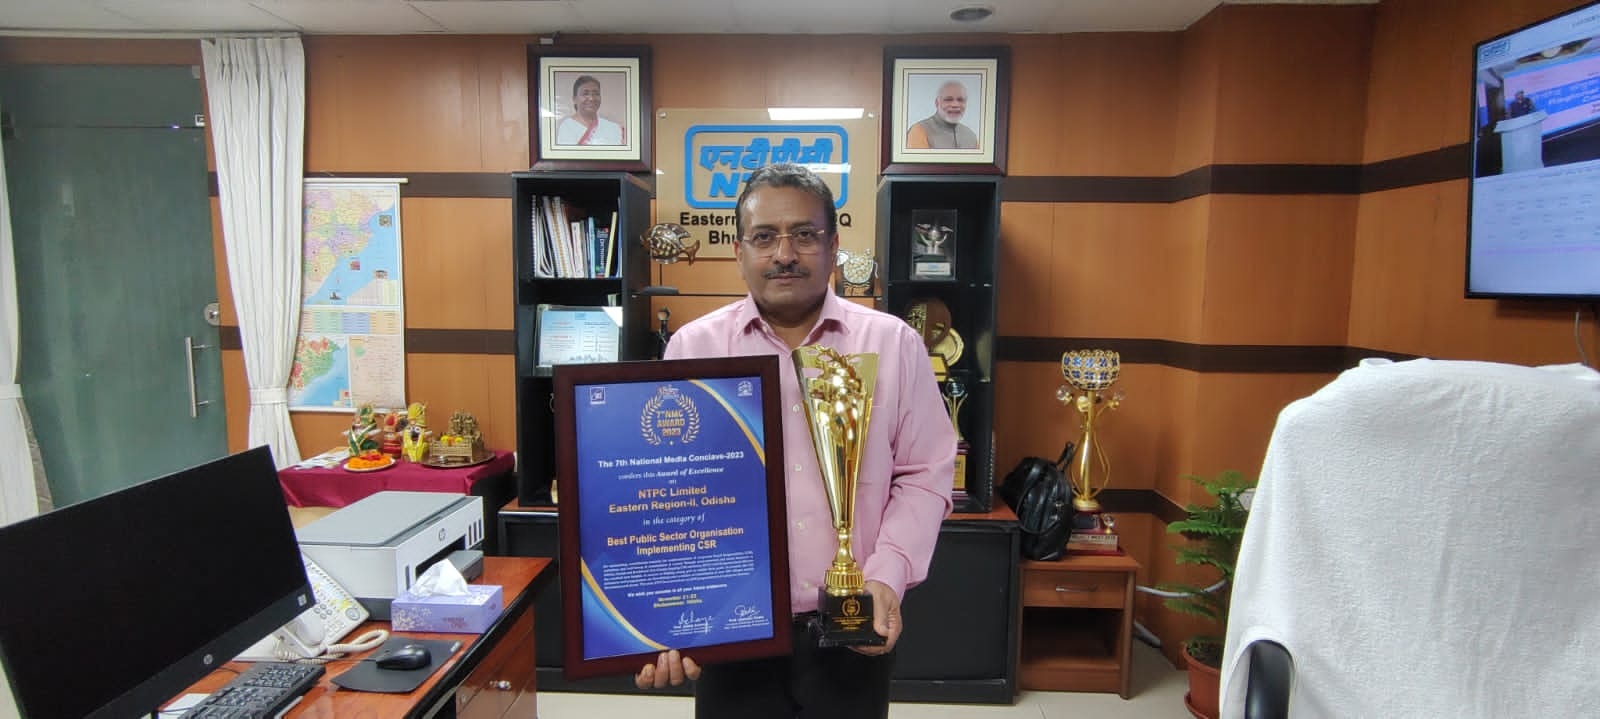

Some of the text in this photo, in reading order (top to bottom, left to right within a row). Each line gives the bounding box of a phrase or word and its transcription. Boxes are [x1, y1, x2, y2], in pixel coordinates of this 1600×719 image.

[698, 137, 833, 171] एनटीपीसी
[657, 418, 685, 428] AWARD
[598, 460, 613, 468] The
[615, 459, 628, 467] 7th
[629, 456, 662, 466] National
[664, 454, 687, 463] Media
[656, 469, 678, 477] Award
[680, 467, 688, 476] of
[638, 484, 707, 499] NTPC Limited
[608, 502, 648, 514] Eastern
[701, 494, 736, 506] Odisha
[643, 514, 705, 526] in the category of
[607, 527, 744, 547] Best Public Sector Organisation
[637, 540, 717, 556] Implementing CSR
